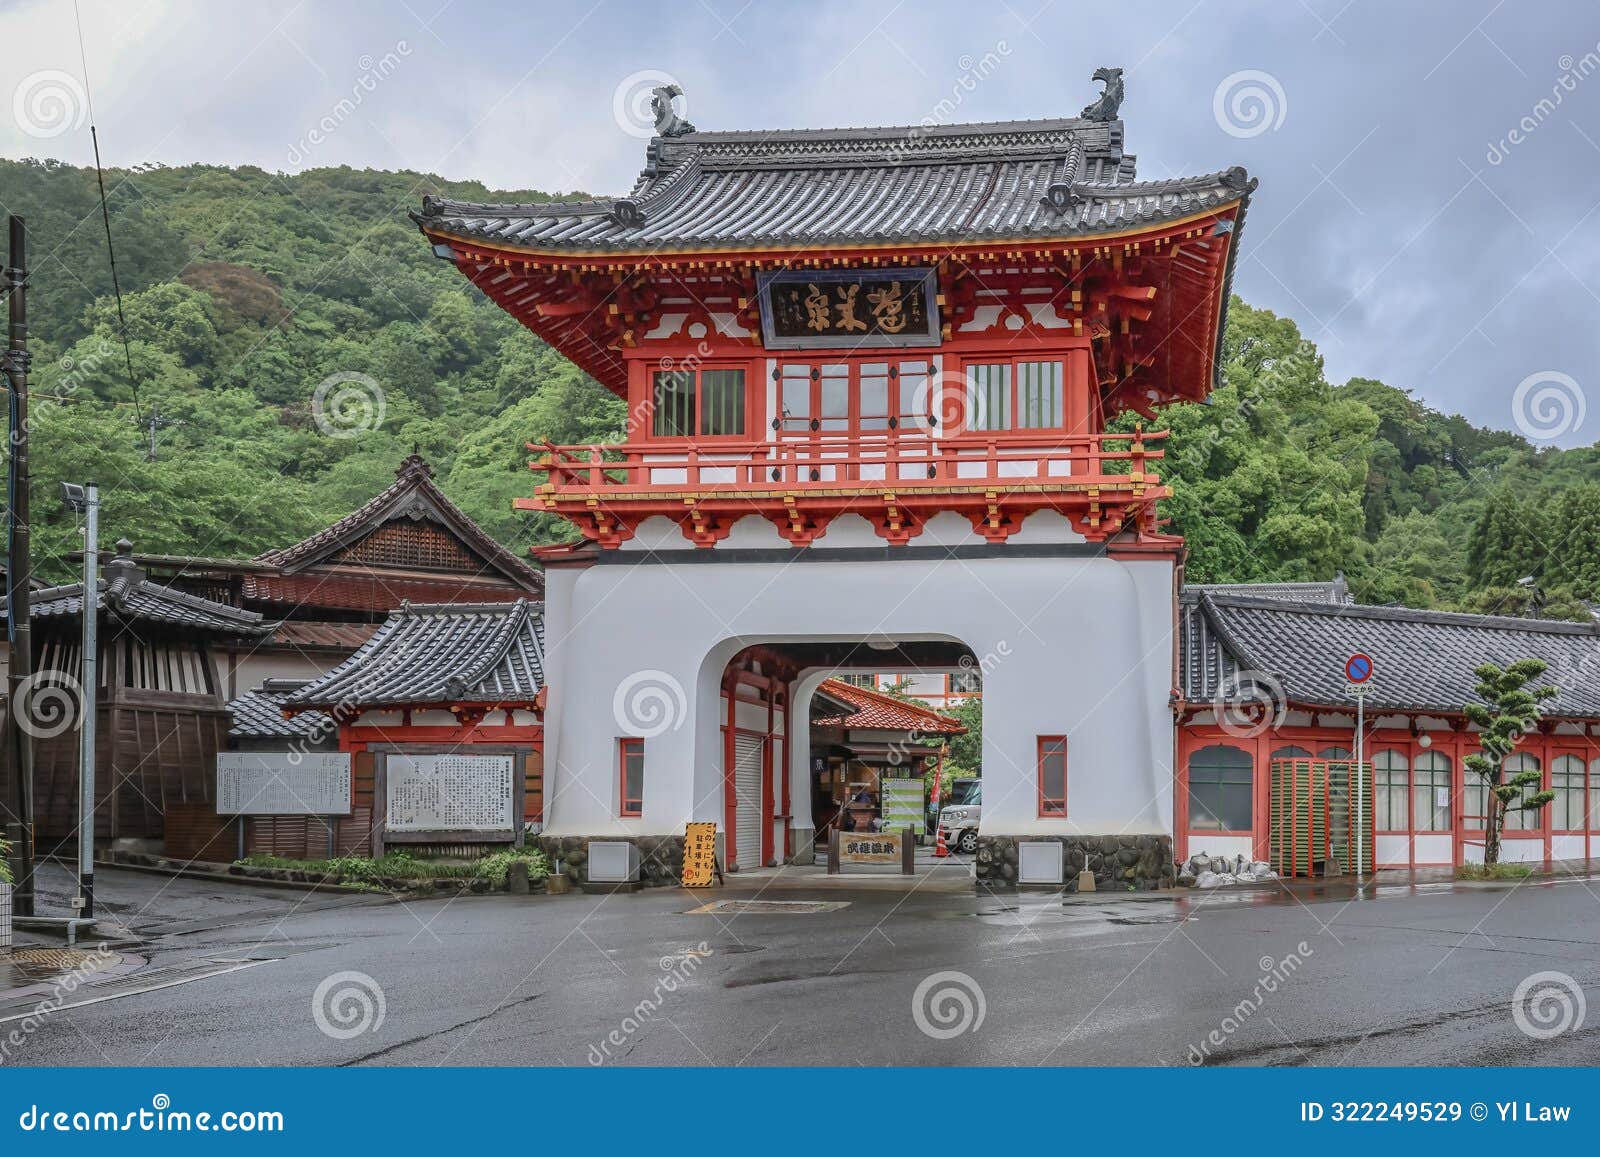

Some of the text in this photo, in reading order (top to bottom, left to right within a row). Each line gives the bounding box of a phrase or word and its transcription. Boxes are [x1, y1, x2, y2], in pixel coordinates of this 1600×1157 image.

[703, 825, 712, 870] この上にも
